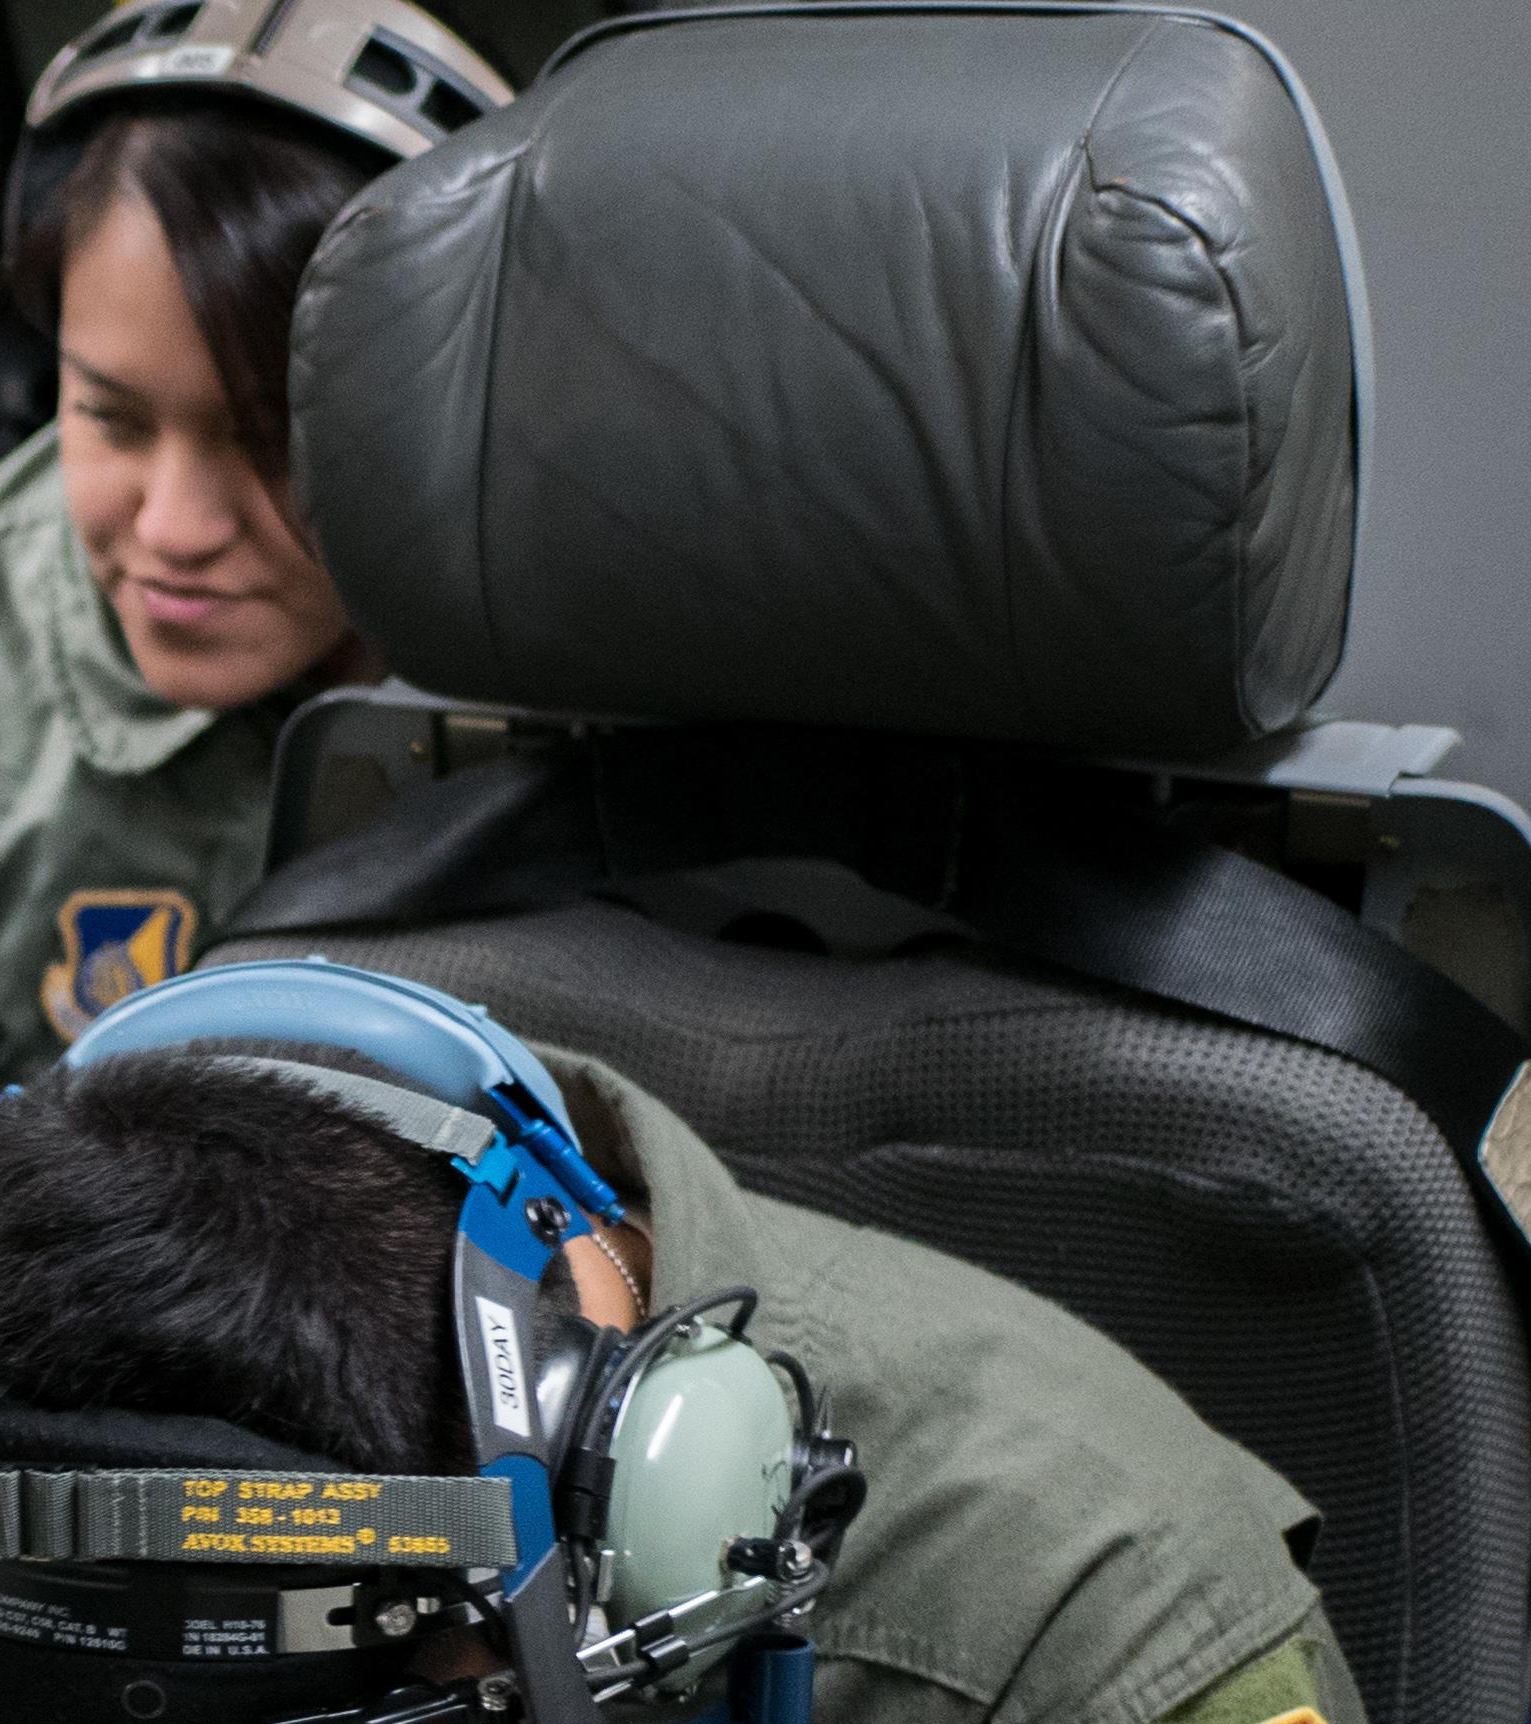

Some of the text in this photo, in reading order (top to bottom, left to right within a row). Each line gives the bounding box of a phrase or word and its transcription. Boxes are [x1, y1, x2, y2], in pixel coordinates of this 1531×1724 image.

[182, 1479, 383, 1500] TOP STRAP ASSY
